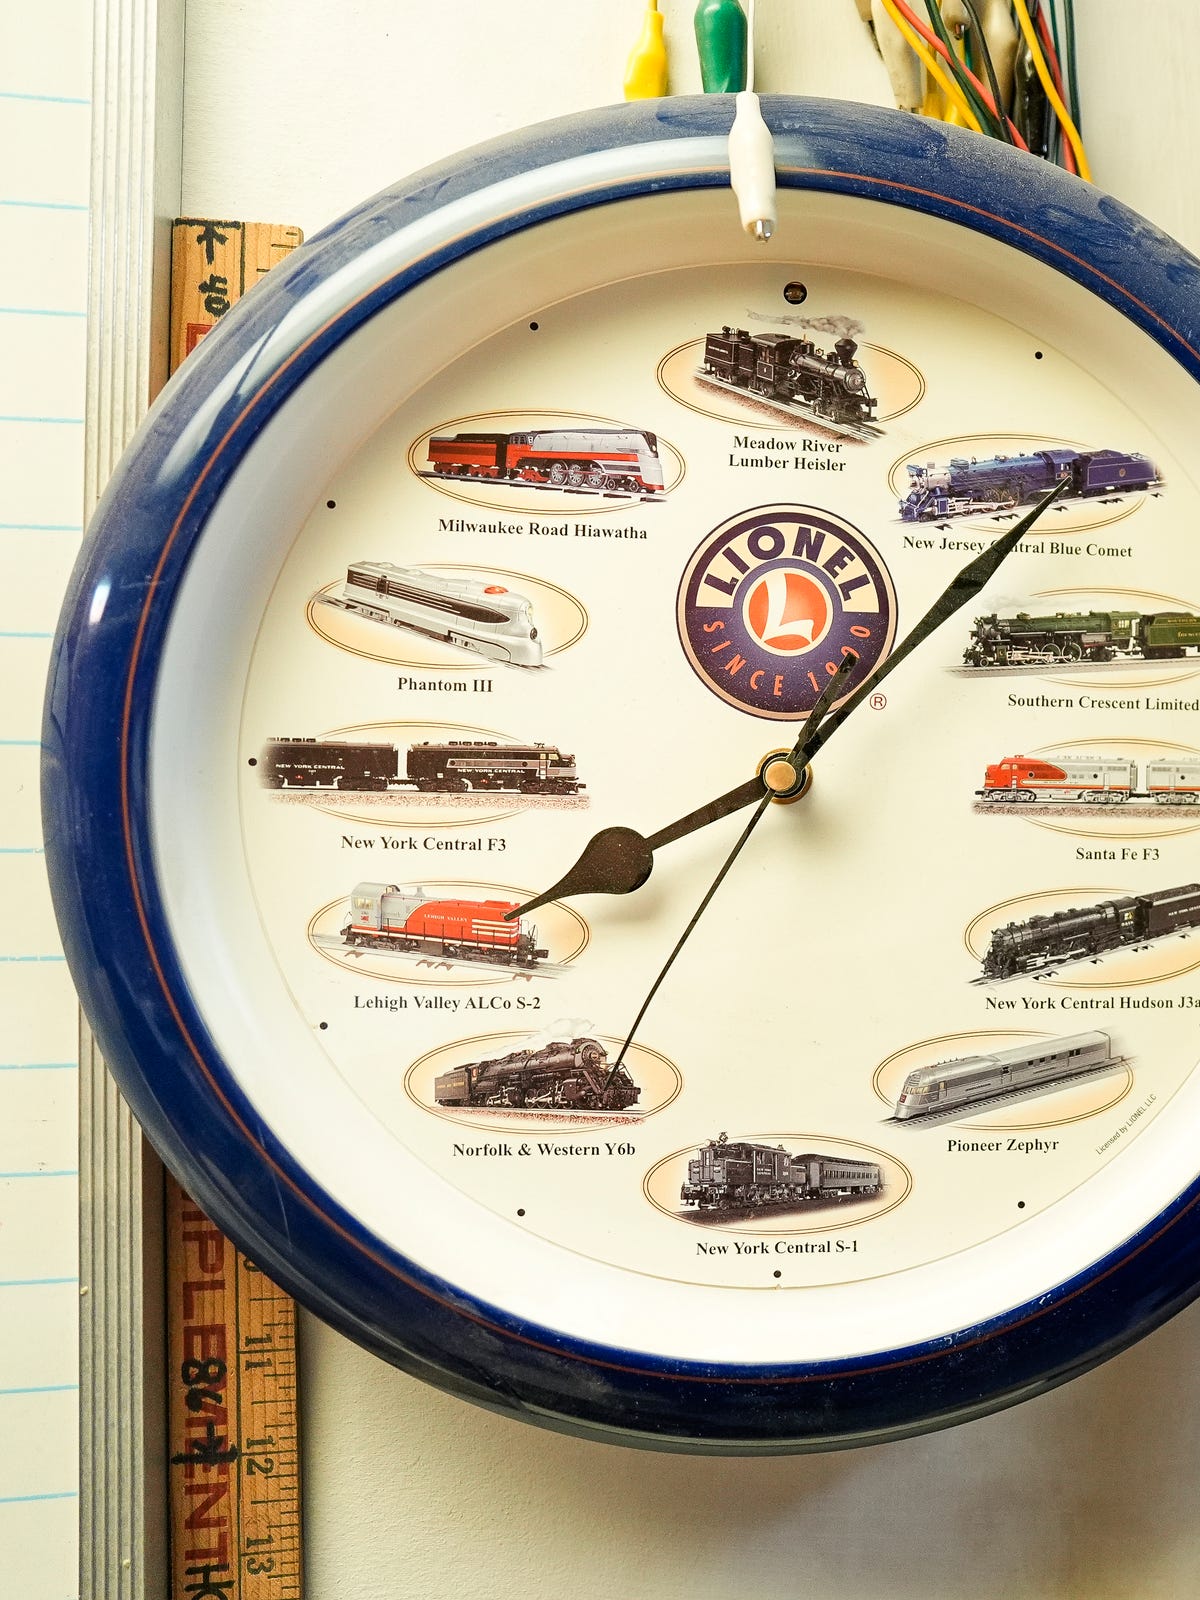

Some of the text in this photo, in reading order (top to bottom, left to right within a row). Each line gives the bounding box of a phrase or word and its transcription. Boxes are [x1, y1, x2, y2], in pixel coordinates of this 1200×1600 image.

[732, 436, 843, 453] Meadow River
[729, 454, 847, 472] Lumber Heisler
[438, 518, 648, 540] Milwaukee Road Hiawatha
[903, 535, 1132, 558] New Jersey ntral Blue Comet
[704, 525, 871, 602] LIONEL
[703, 622, 784, 697] SINCE
[397, 677, 493, 693] Phantom III
[1008, 693, 1200, 712] Southern Crescent Limited
[341, 835, 506, 852] New York Central F3
[1075, 847, 1160, 861] Santa Fe F3
[354, 995, 541, 1013] Lehigh Valley ALCo S-2
[985, 996, 1017, 1010] New
[1021, 996, 1056, 1010] York
[1060, 996, 1115, 1010] Central
[1119, 996, 1174, 1010] Hudson
[1126, 1106, 1147, 1127] LIONEL
[452, 1142, 636, 1157] Norfolk & Western Y6b
[947, 1138, 1060, 1155] Pioneer Zephyr
[696, 1239, 858, 1256] New York Central S-1
[246, 1435, 276, 1476] 12
[246, 1533, 276, 1576] 13
